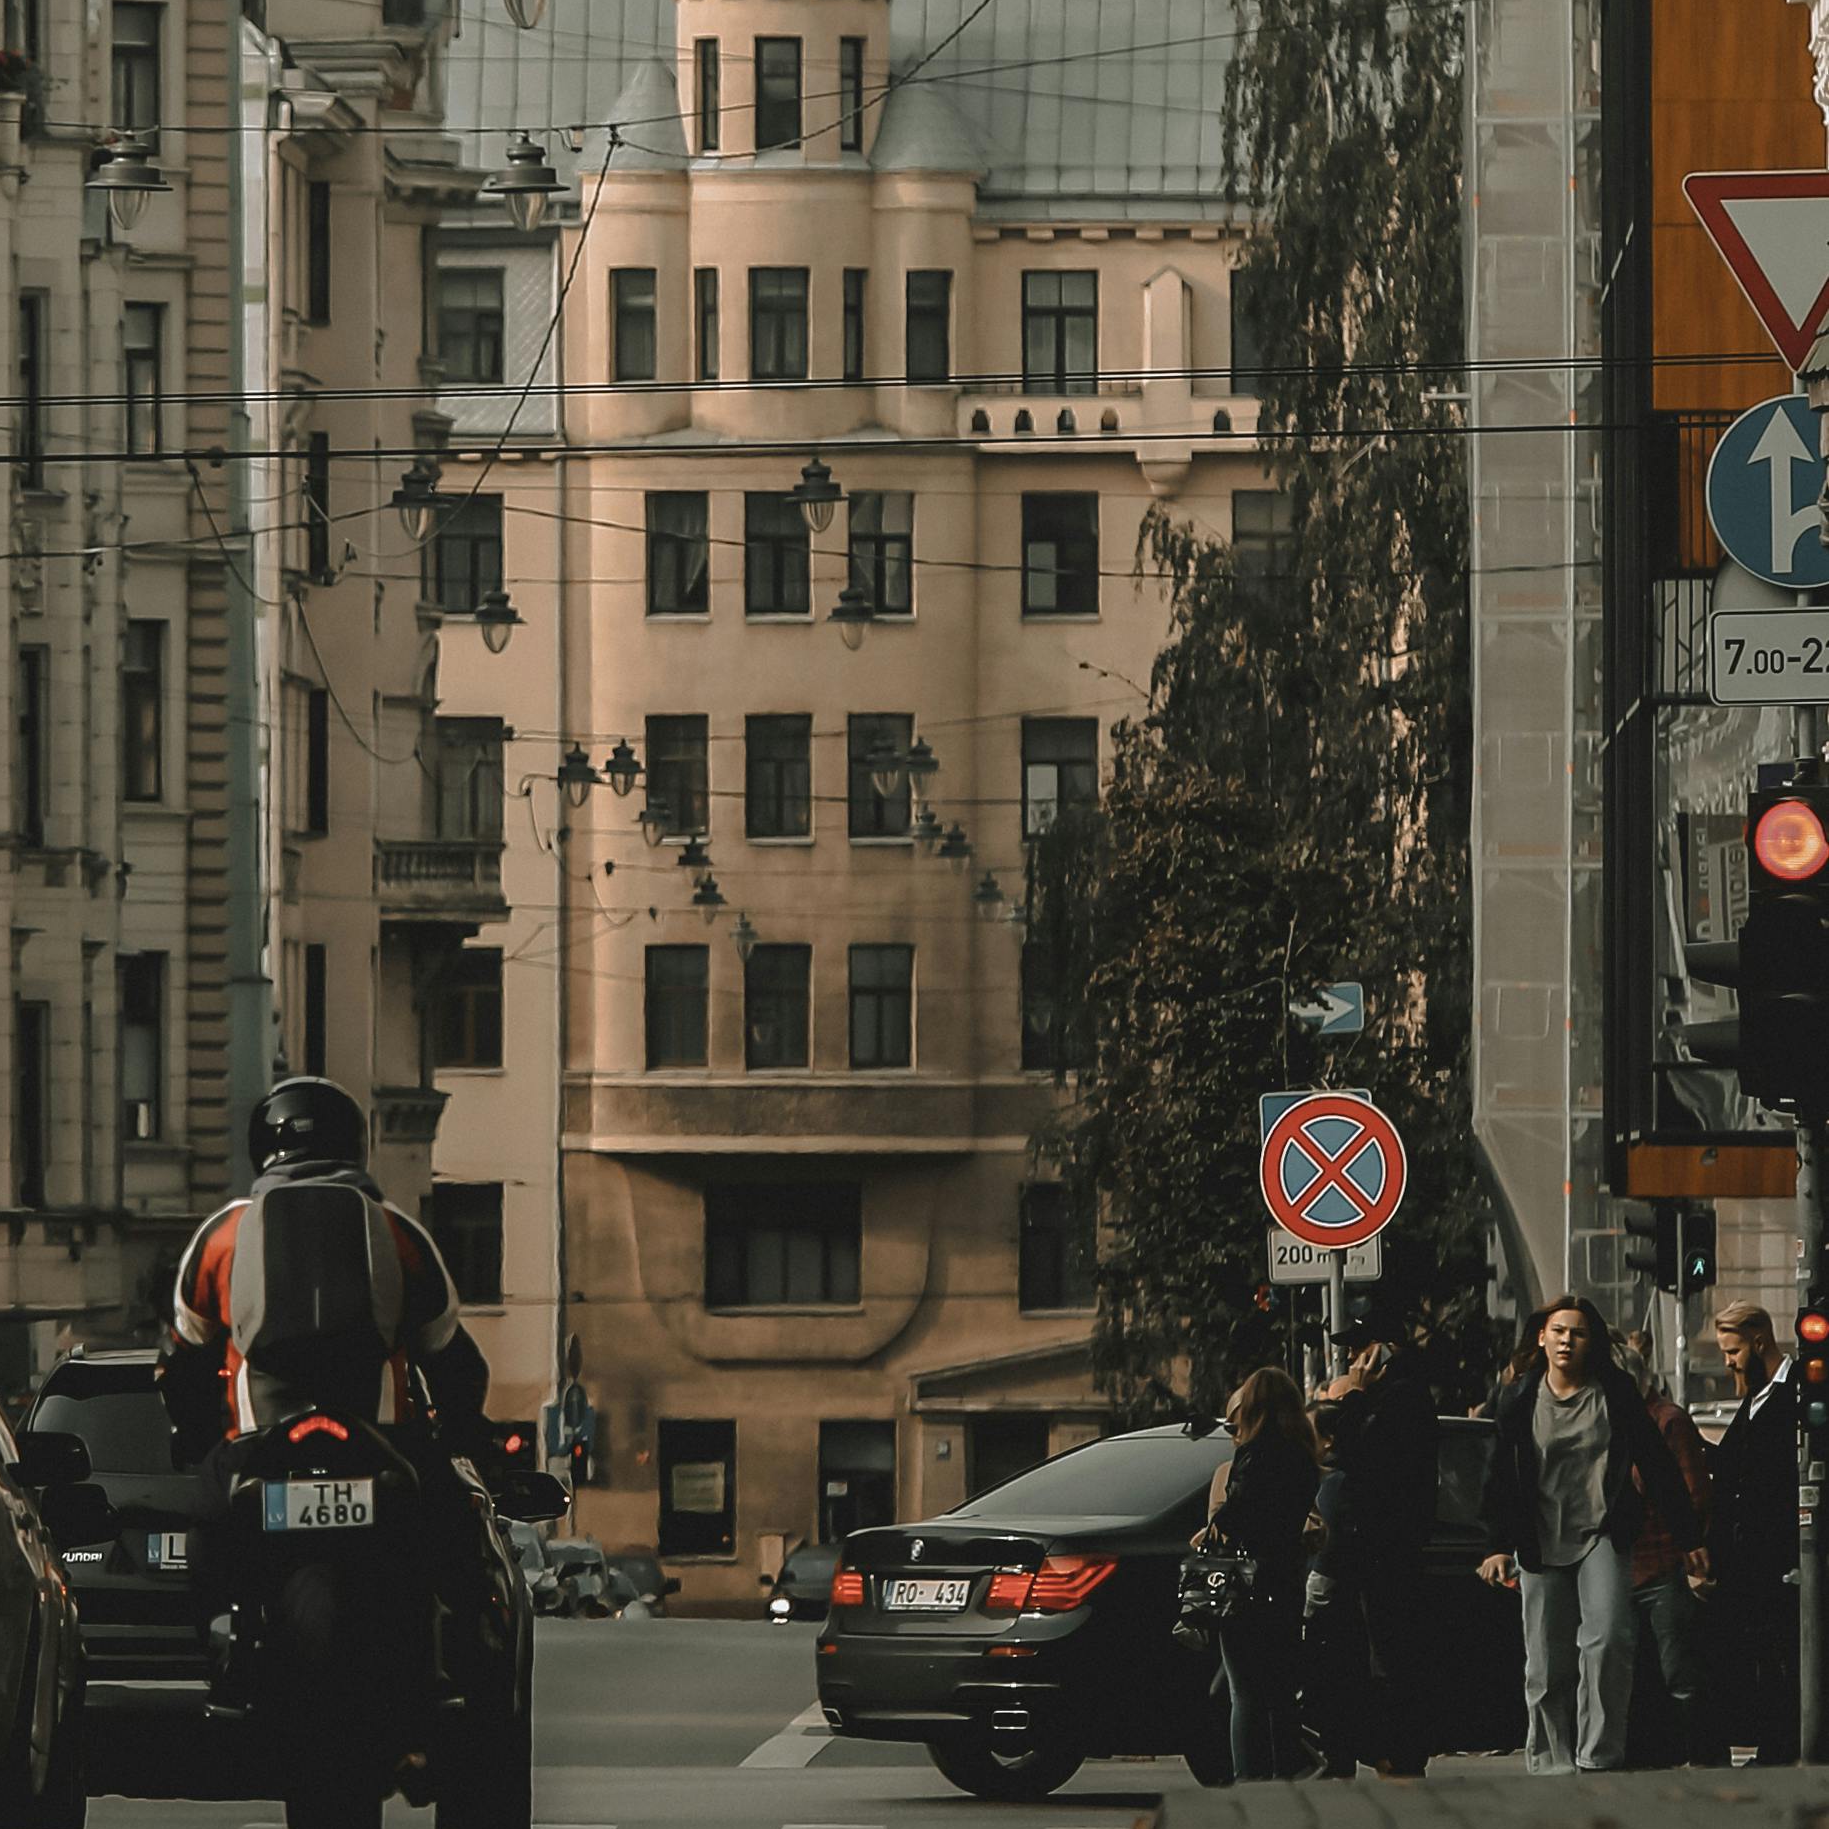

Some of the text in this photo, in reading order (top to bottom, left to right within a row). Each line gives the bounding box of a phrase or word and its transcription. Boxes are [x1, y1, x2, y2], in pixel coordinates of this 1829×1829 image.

[1725, 637, 1829, 675] 7.00-2
[1277, 1245, 1313, 1266] 200
[313, 1483, 352, 1504] TH
[268, 1512, 284, 1523] LV
[298, 1503, 367, 1526] 4680
